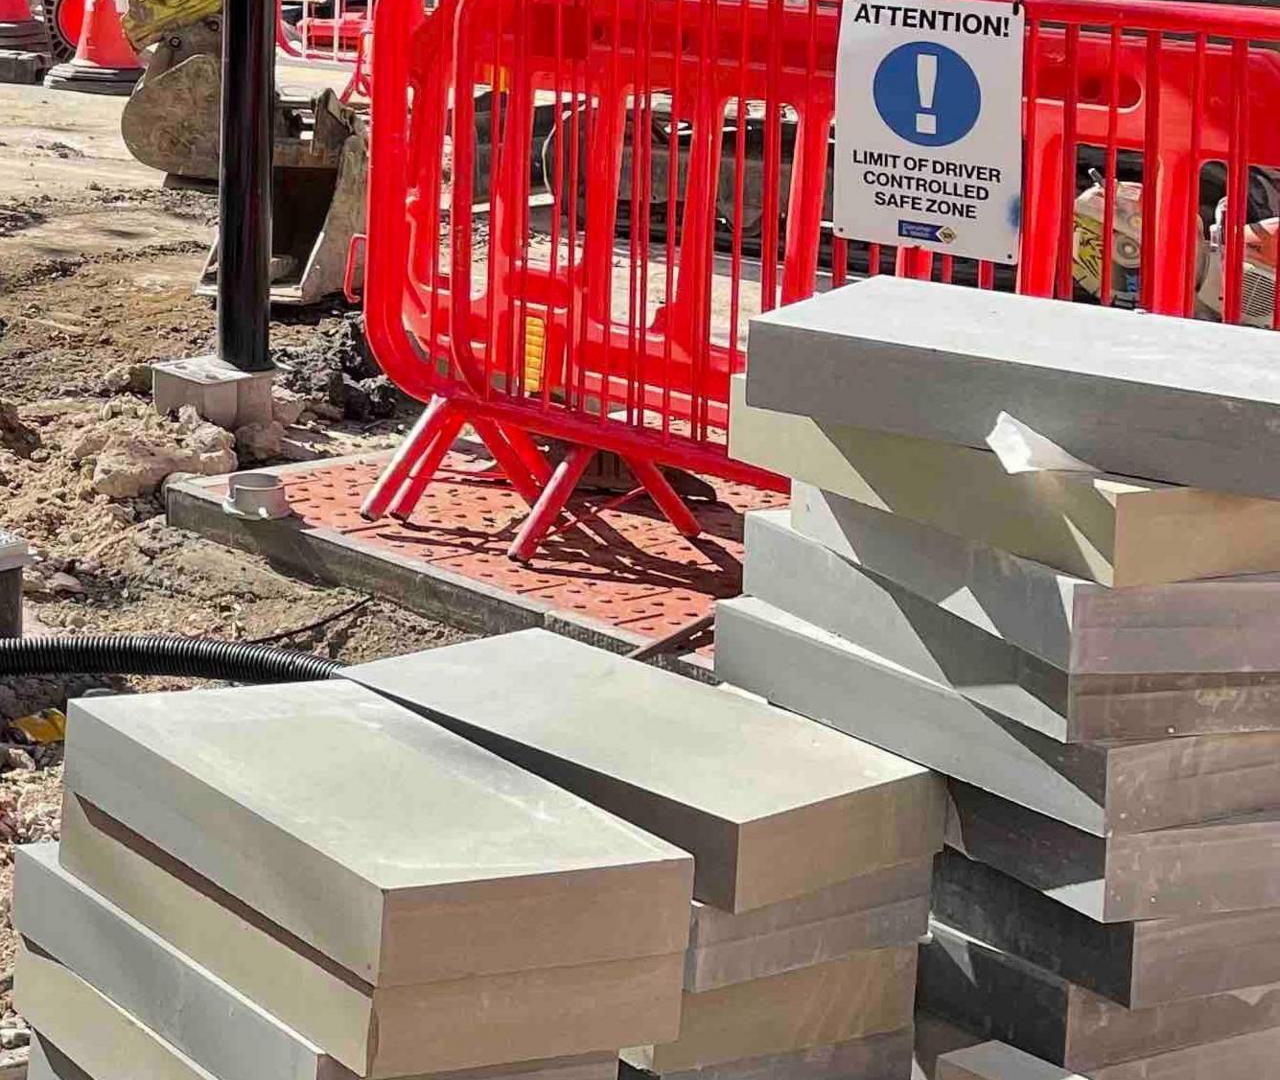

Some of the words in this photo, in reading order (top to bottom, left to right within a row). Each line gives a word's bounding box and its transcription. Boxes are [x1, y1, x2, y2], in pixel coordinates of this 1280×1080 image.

[854, 3, 1011, 37] ATTENTION!
[852, 149, 901, 168] LIMIT
[903, 156, 929, 173] OF
[932, 160, 1001, 183] DRIVER
[863, 170, 990, 201] CONTROLLED
[874, 191, 923, 211] SAFE
[925, 198, 977, 219] ZONE
